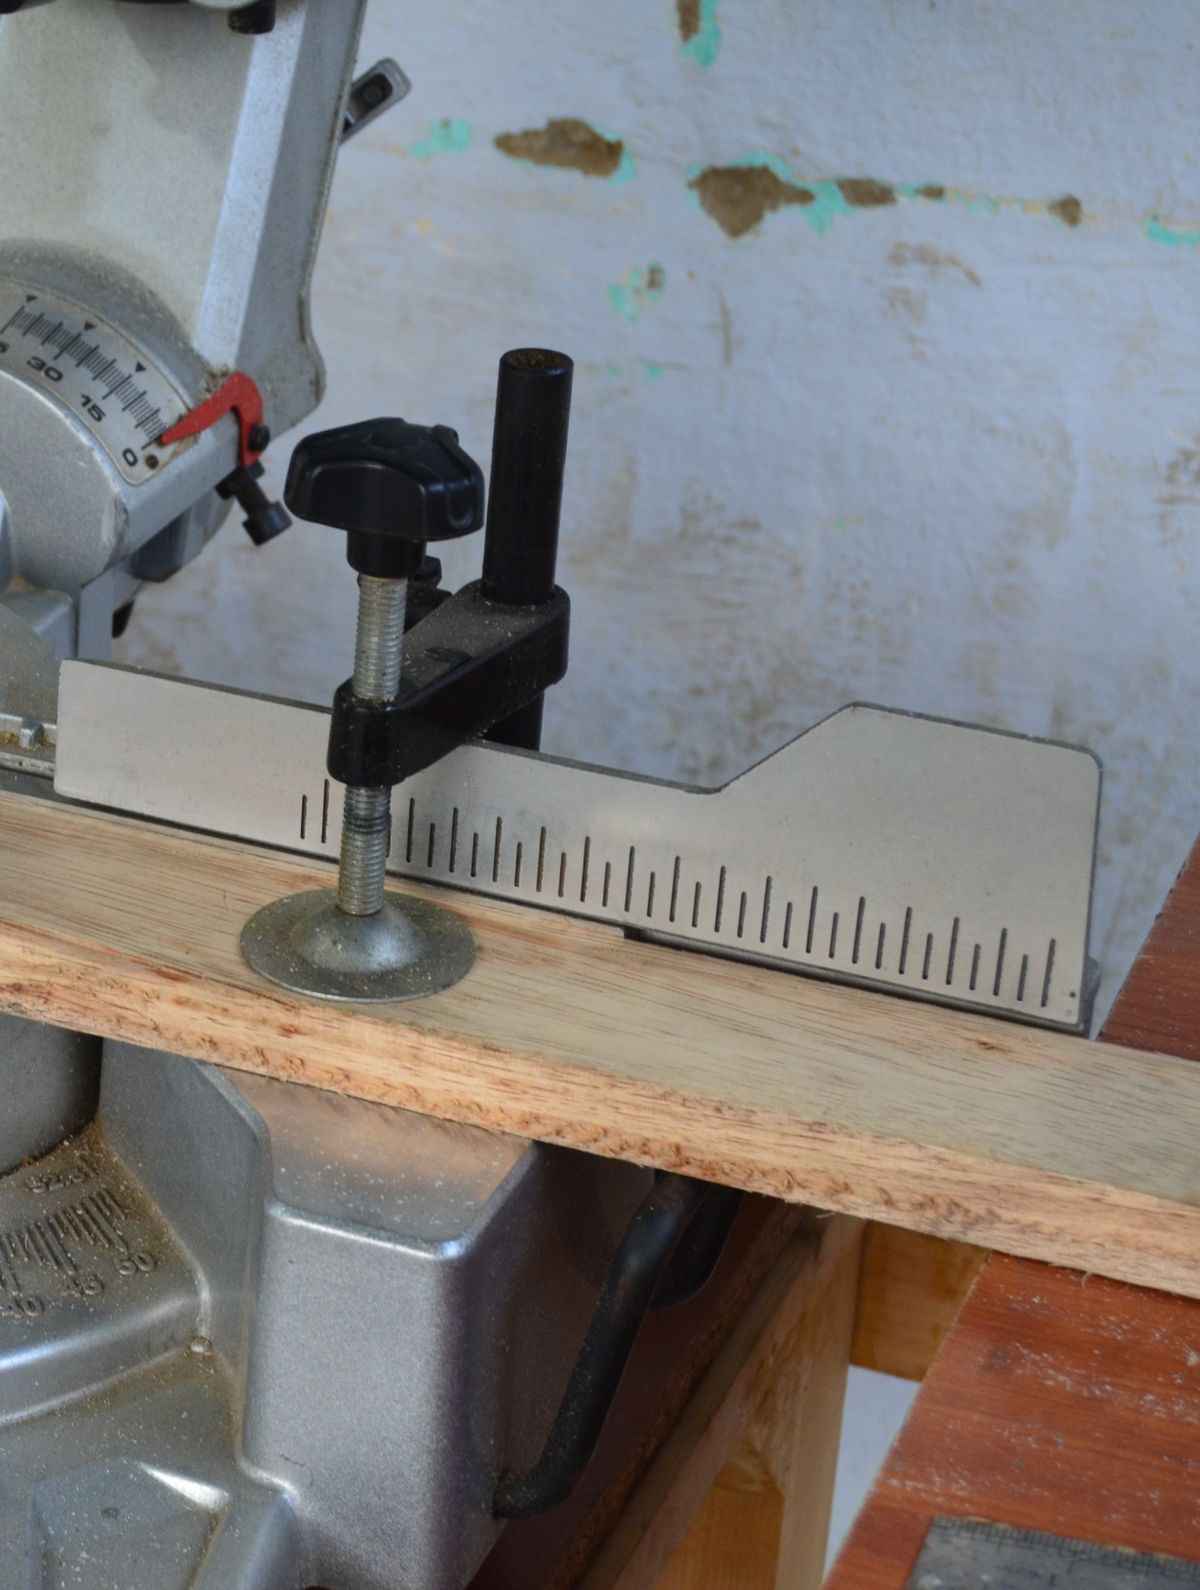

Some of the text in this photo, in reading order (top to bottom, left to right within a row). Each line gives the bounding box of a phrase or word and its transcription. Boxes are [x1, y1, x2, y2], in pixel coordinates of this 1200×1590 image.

[27, 356, 63, 382] 30
[81, 393, 106, 422] 15
[122, 448, 138, 467] 0
[1, 1296, 44, 1319] 40
[64, 1273, 102, 1298] 45
[116, 1251, 156, 1276] 50
